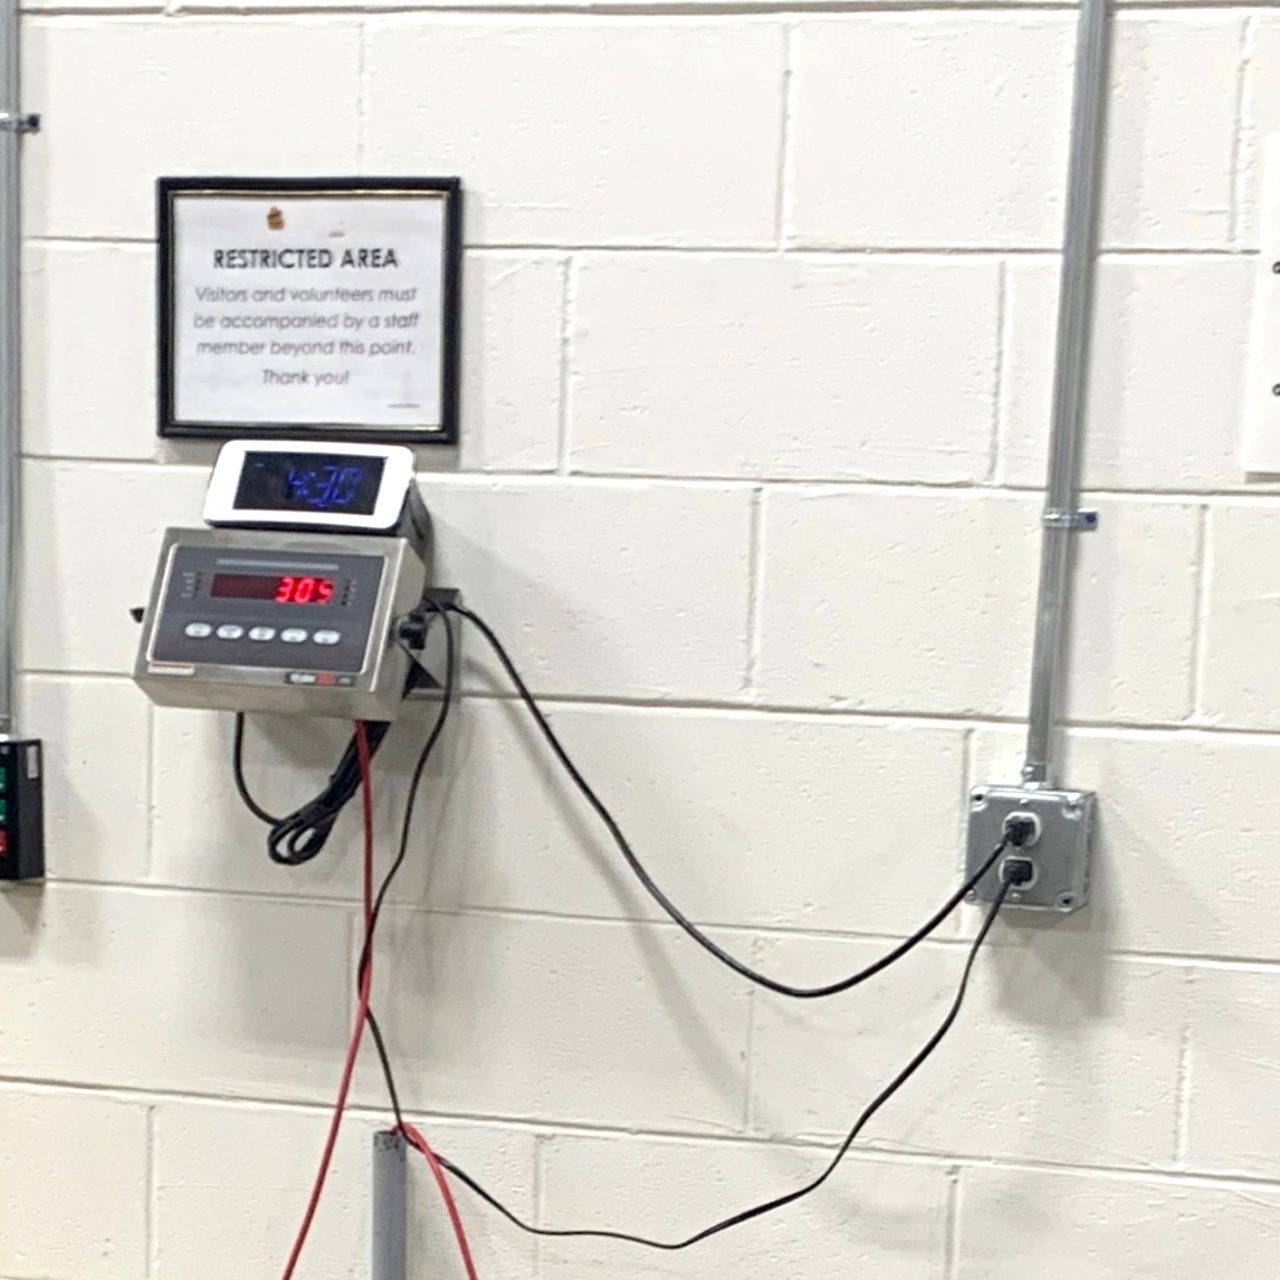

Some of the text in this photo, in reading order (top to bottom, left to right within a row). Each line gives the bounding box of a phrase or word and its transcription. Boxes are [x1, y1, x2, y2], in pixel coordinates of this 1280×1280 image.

[213, 248, 400, 269] RESTRICTED AREA
[195, 286, 418, 302] Visitors and volunteers must
[193, 311, 420, 333] be accompanied by a staff
[196, 339, 416, 358] member beyond this point.
[262, 368, 351, 388] Thank you!
[274, 576, 335, 606] 305
